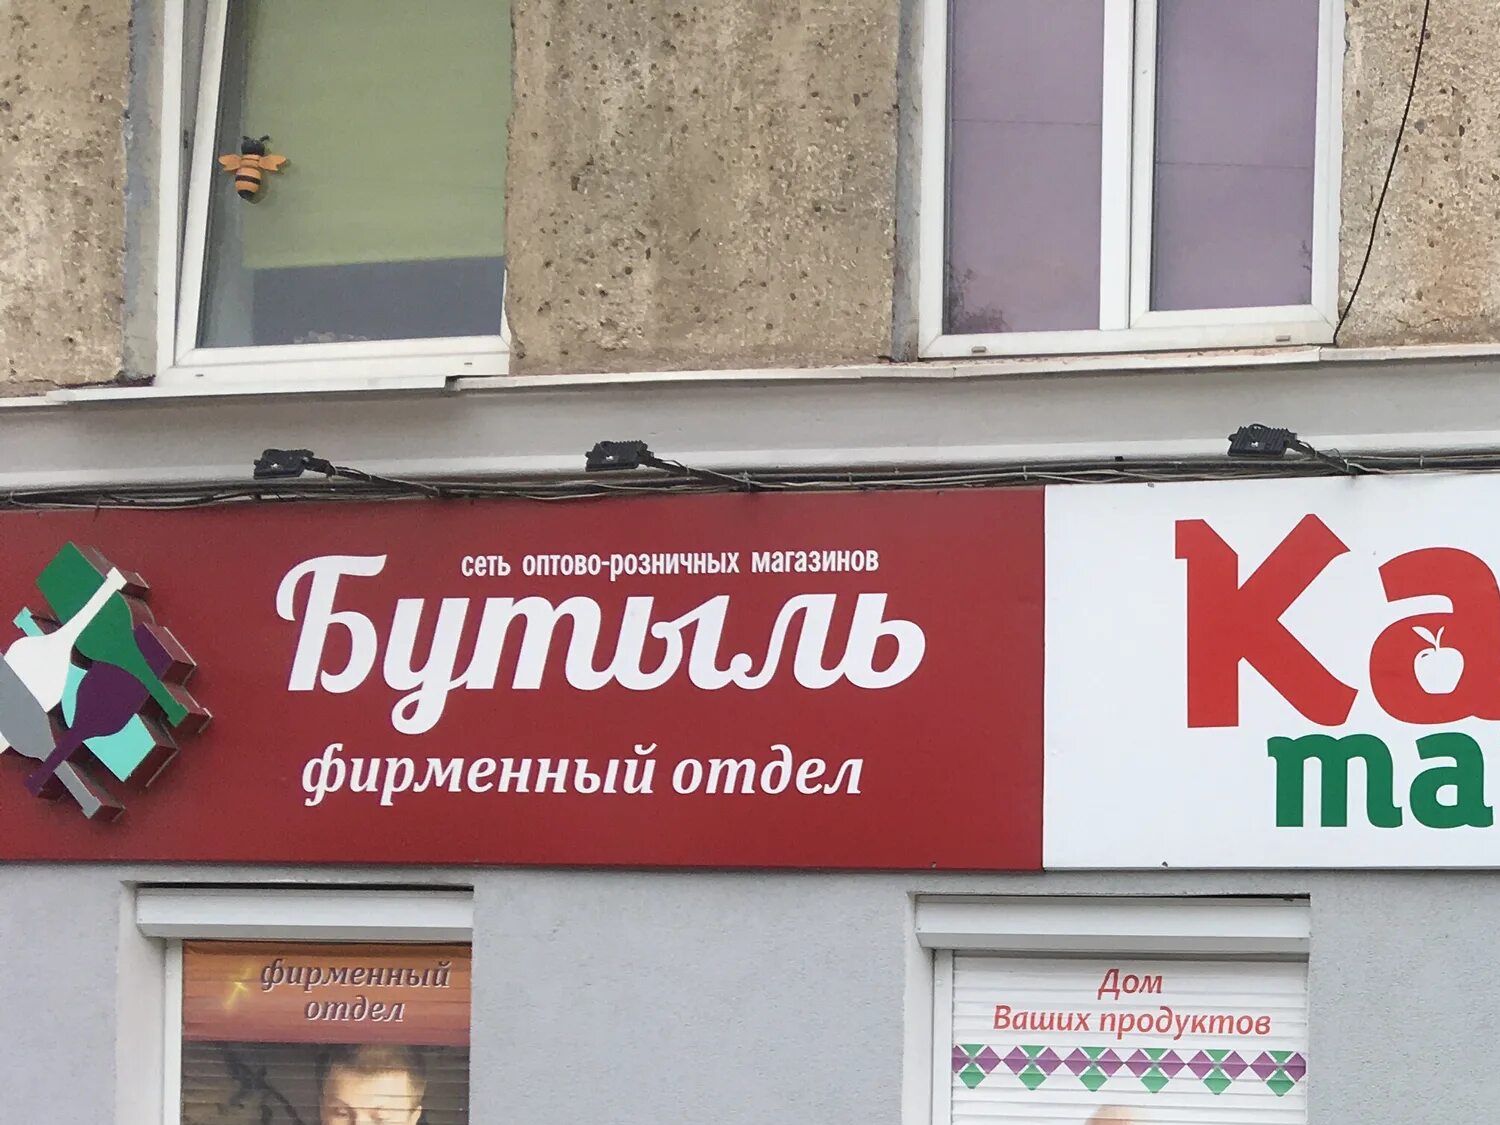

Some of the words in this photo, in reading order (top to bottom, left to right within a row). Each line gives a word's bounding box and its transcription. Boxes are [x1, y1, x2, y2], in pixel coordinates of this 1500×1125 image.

[461, 555, 512, 577] сеть
[522, 552, 740, 581] оптово-розничных
[751, 549, 879, 573] магазинов
[275, 554, 926, 735] Бутыль
[302, 742, 658, 807] фирменный
[672, 743, 864, 795] отдел
[260, 958, 451, 993] фирменный
[1097, 969, 1163, 999] Дом
[304, 995, 404, 1023] отдел
[993, 1004, 1090, 1031] Ваших
[1099, 1006, 1271, 1041] продуктов
